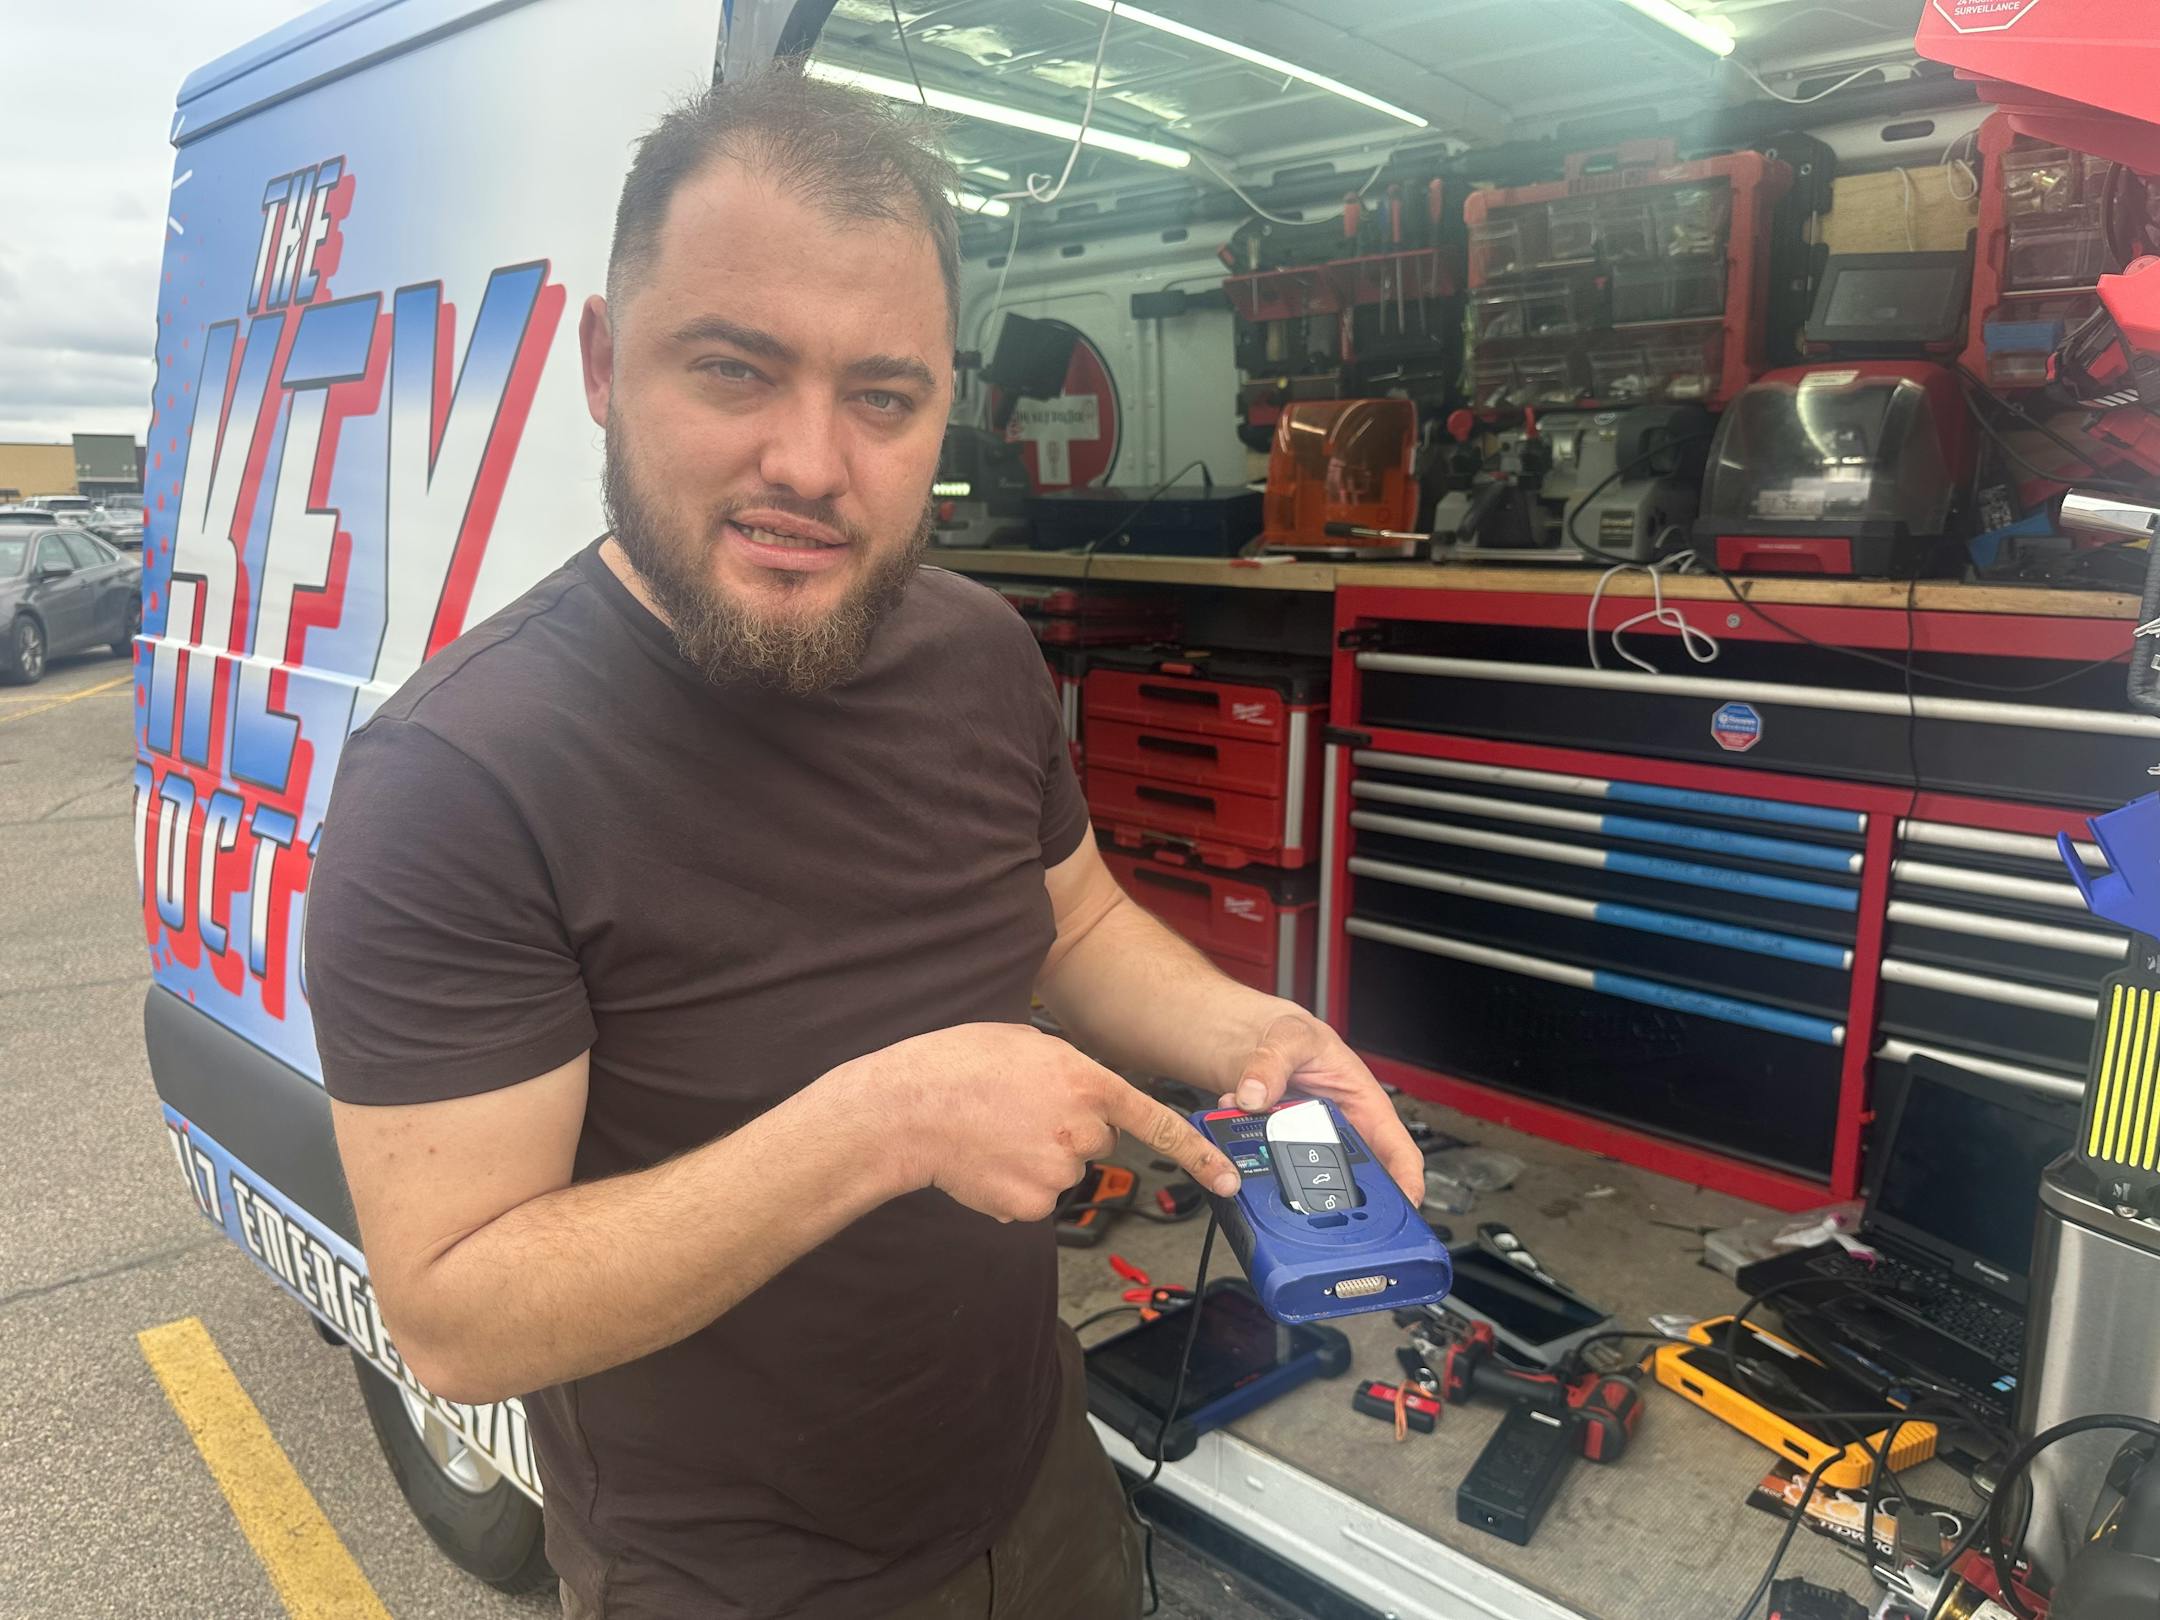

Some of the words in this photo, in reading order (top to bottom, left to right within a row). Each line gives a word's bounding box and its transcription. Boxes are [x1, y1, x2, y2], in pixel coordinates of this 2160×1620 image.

[1954, 1, 2020, 16] SURVEILLANCE
[247, 155, 347, 316] THE
[147, 258, 553, 794] KEY
[134, 759, 323, 1000] OCT
